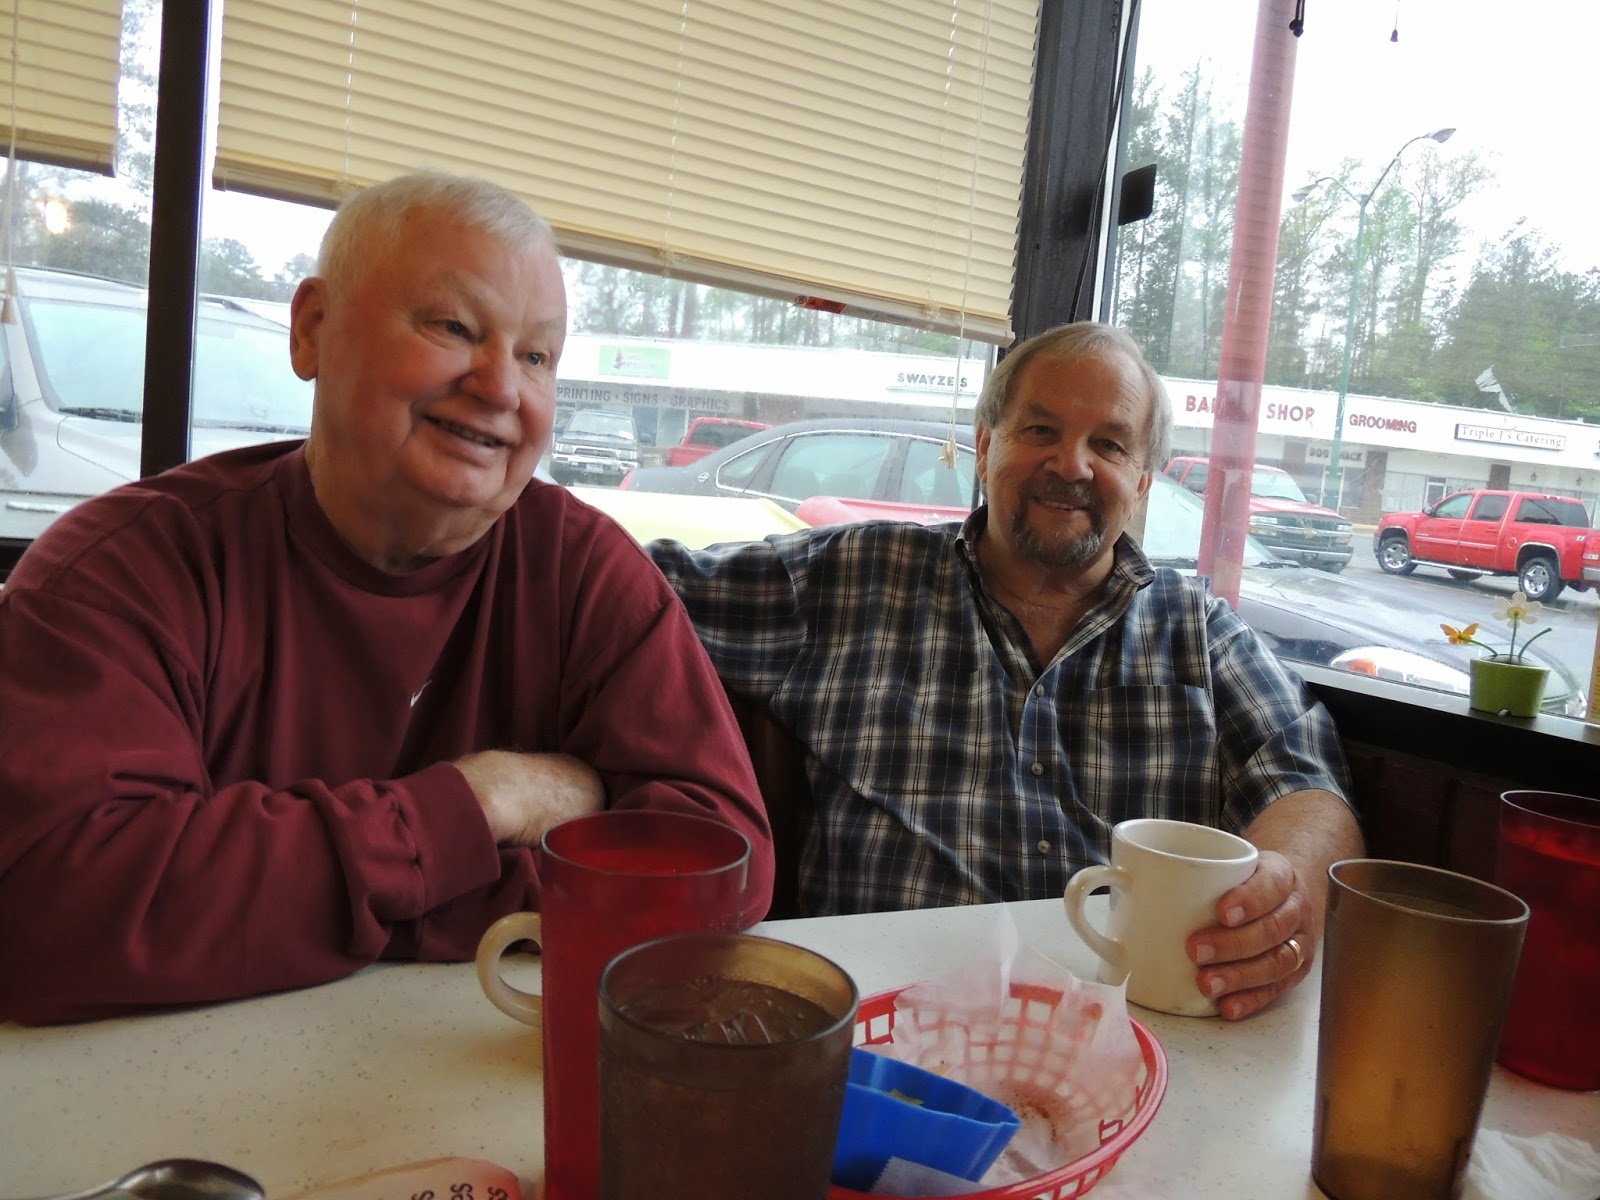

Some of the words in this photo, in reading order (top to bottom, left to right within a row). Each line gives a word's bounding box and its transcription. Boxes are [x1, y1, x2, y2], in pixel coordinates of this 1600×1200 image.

[897, 372, 968, 388] SWAYZES
[556, 385, 611, 402] PRINTING
[623, 388, 659, 405] SIGNS
[669, 392, 730, 410] GRAPHICS
[1266, 402, 1316, 421] SHOP
[1349, 413, 1417, 433] GROOMING
[1462, 426, 1495, 440] Triple
[1516, 432, 1562, 448] Catering
[1338, 450, 1363, 462] HACK
